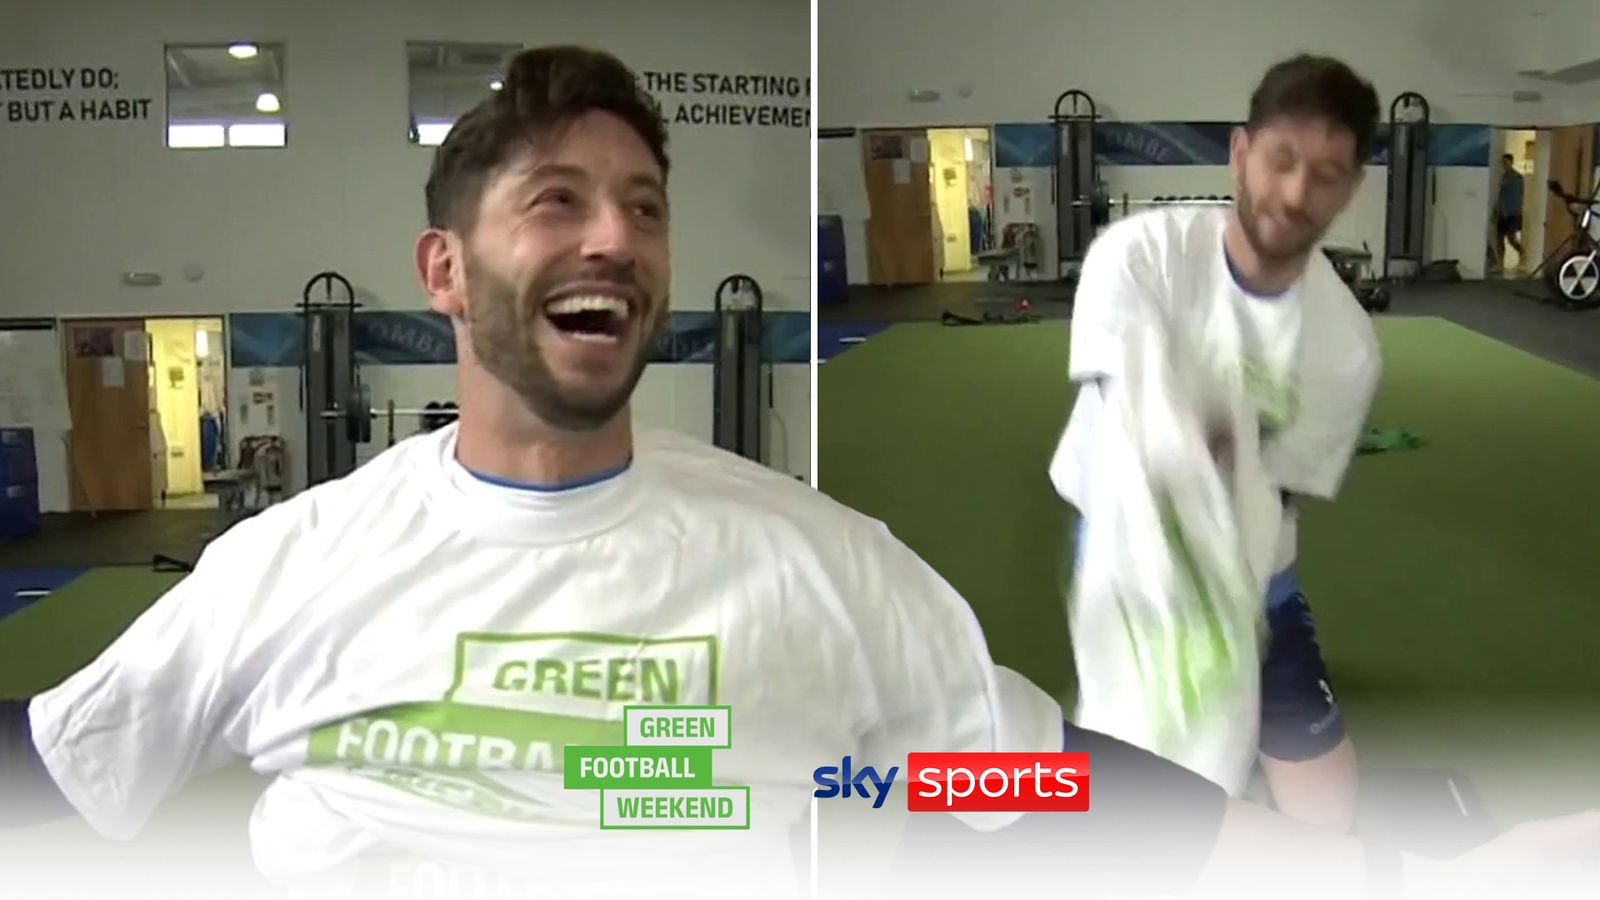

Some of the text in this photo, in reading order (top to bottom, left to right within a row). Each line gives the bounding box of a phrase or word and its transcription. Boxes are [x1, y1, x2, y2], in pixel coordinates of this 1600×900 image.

[0, 69, 119, 90] TEDLY DO;
[644, 72, 687, 92] THE
[692, 74, 800, 97] STARTING
[8, 99, 57, 122] BUT
[58, 99, 76, 121] A
[80, 99, 152, 121] HABIT
[492, 658, 678, 704] GREEN
[336, 719, 558, 771] FOOTBA
